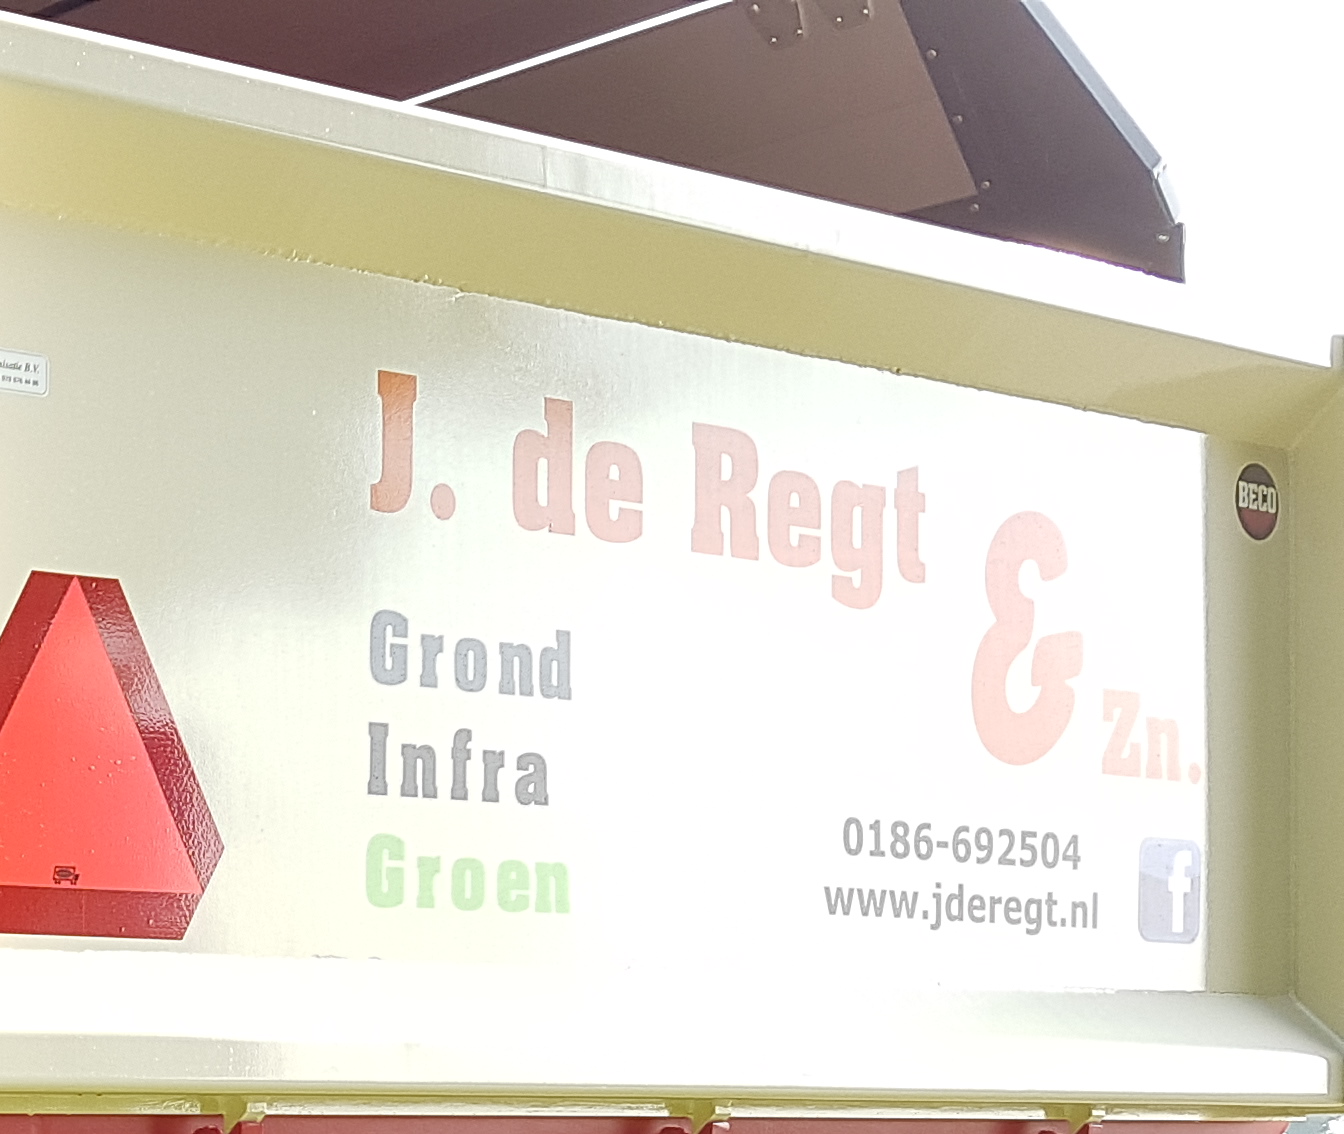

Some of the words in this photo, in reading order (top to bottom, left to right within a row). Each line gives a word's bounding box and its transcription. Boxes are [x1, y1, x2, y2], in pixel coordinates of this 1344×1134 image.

[1237, 480, 1278, 514] BECO
[370, 369, 456, 521] J.
[512, 396, 644, 543] de
[691, 421, 926, 610] Regt
[971, 510, 1084, 767] &
[1102, 688, 1202, 785] Zn.
[368, 609, 572, 701] Grond
[367, 722, 550, 806] Infra
[365, 832, 572, 915] Groen
[842, 816, 1082, 871] 0186-692504
[823, 881, 1099, 936] www.jderegt.nl
